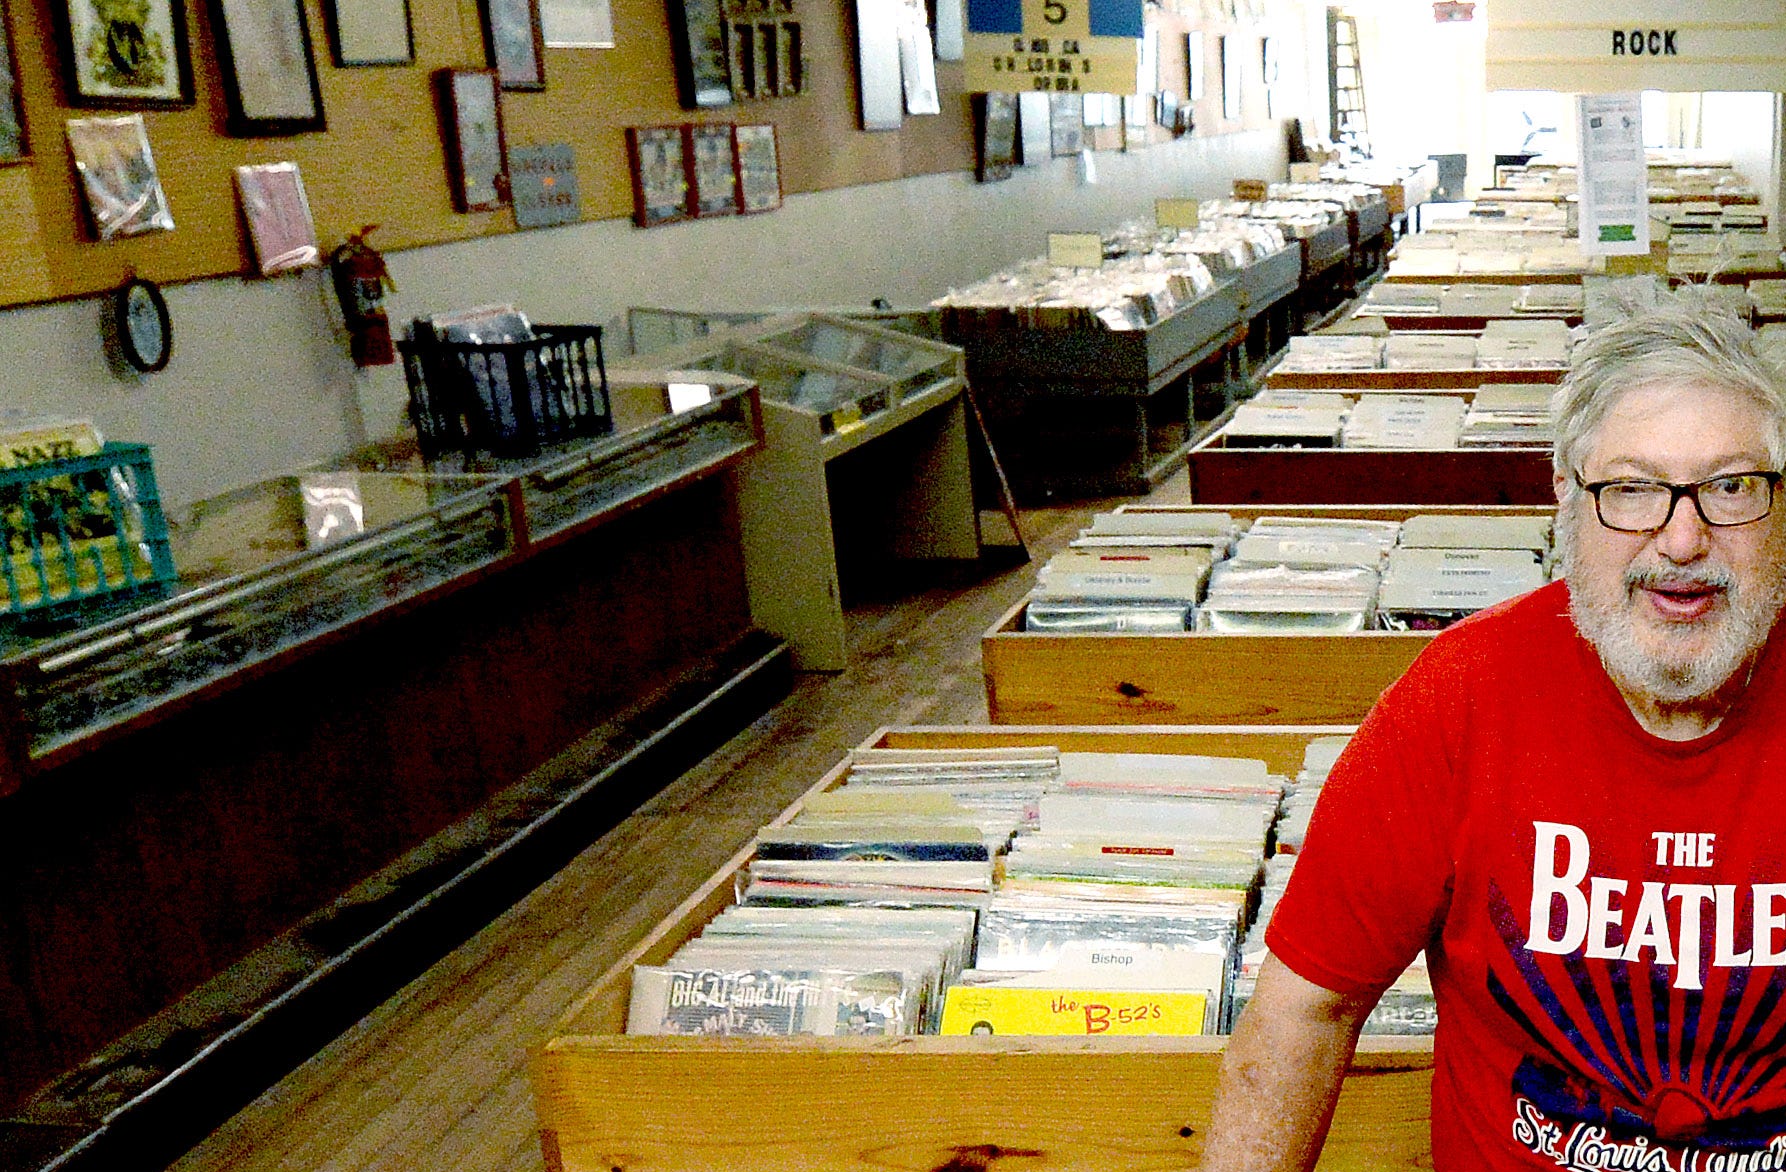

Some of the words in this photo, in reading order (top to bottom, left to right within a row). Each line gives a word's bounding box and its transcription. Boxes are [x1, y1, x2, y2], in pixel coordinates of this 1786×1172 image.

[1043, 0, 1067, 24] 5
[1613, 30, 1677, 55] ROCK
[1651, 831, 1717, 868] THE
[1091, 952, 1134, 966] Bishop
[1051, 995, 1080, 1014] the
[1084, 1001, 1161, 1034] B-52's
[1512, 1098, 1563, 1163] St.
